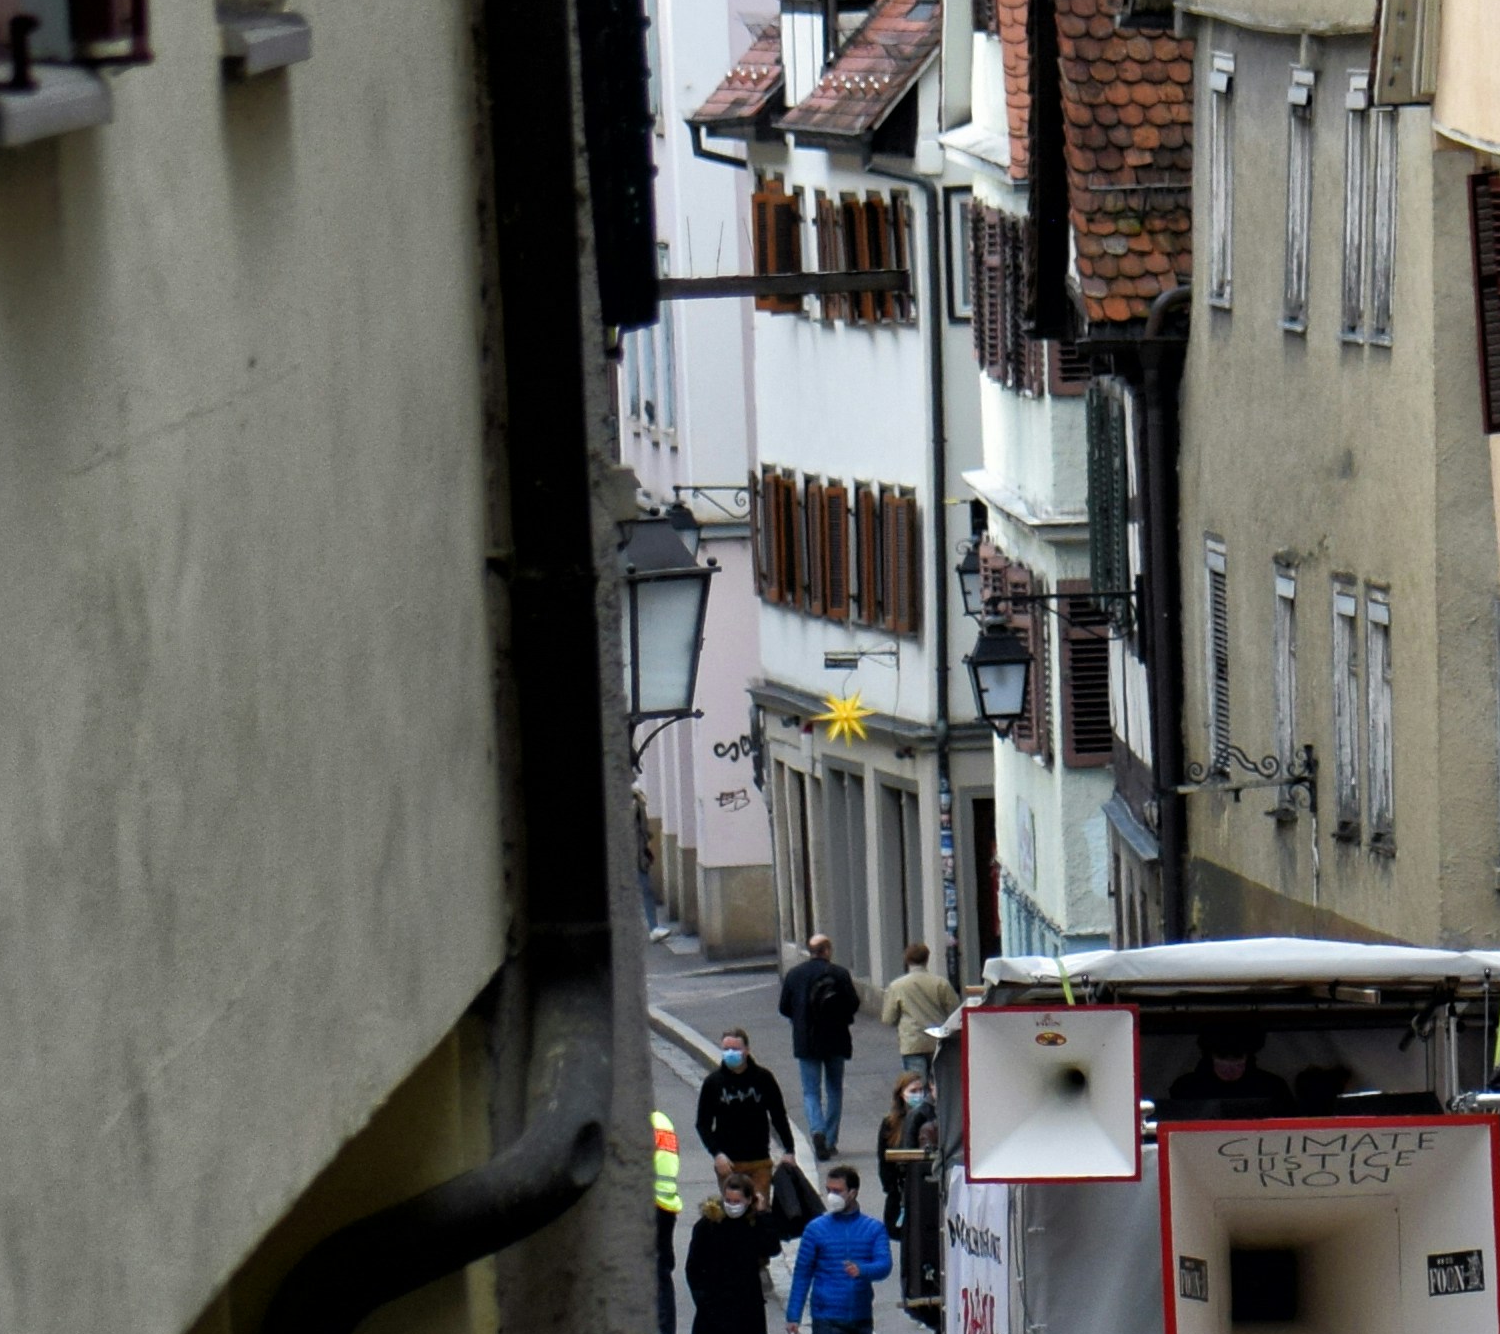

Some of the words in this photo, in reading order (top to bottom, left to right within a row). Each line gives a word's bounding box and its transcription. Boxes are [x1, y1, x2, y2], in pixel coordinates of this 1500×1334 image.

[1217, 1132, 1438, 1156] CLIMATE
[1229, 1150, 1416, 1173] JUSTICE
[1260, 1167, 1391, 1187] NOW
